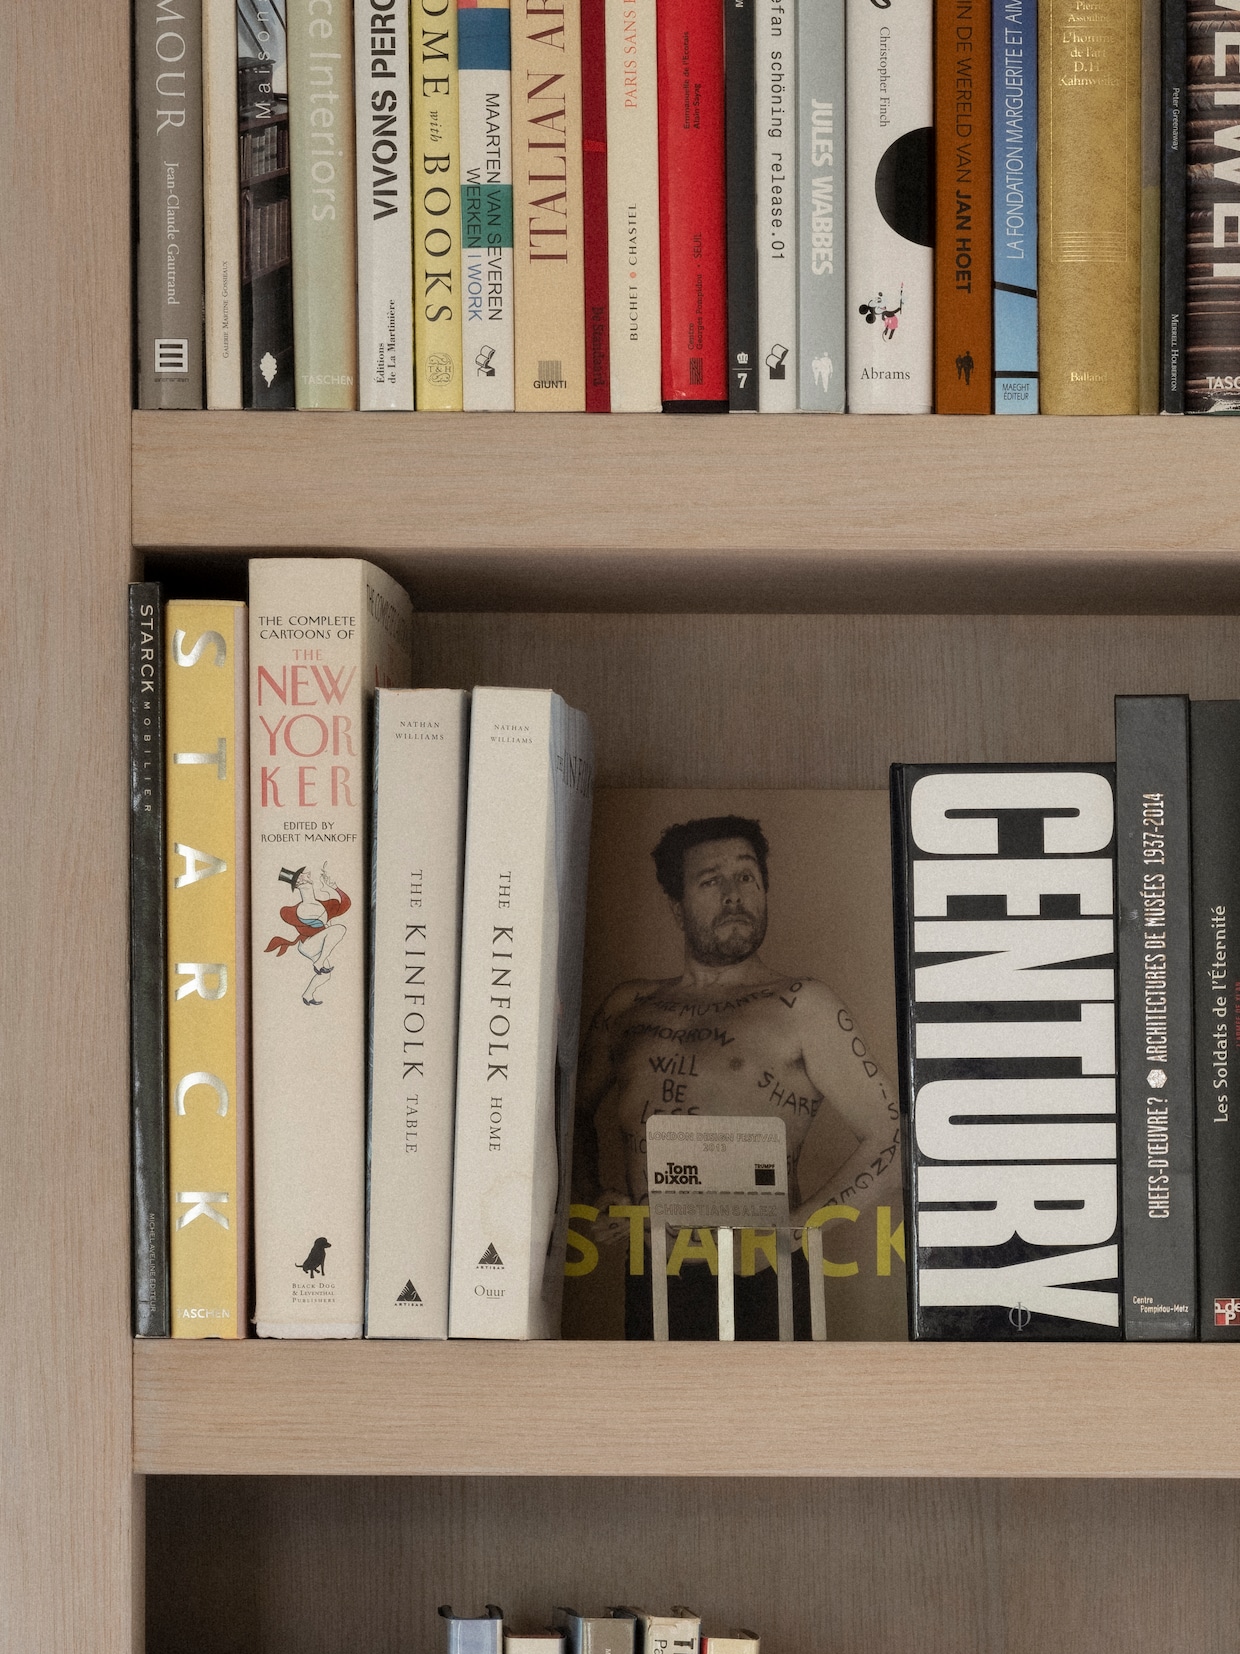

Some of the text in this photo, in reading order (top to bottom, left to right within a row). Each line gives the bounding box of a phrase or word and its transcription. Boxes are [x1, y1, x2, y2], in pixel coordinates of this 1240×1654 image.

[878, 26, 891, 128] Christopher Finch
[1170, 87, 1181, 151] Peter Greenaway
[485, 92, 503, 322] MAARTEN VAN SEVEREN
[526, 70, 569, 264] ITALIAN
[767, 50, 788, 262] schöning release.01
[811, 98, 834, 276] JULES WABBES
[164, 161, 181, 305] Jean-Claude Gautrand
[422, 152, 453, 323] BOOKS
[466, 167, 483, 322] WERKEN WORK
[628, 202, 638, 342] BUCHET CHASTEL
[955, 189, 972, 295] JAN HOET
[533, 380, 567, 389] GIUNTI
[861, 367, 911, 381] Abrams
[259, 628, 335, 641] CARTOONS
[288, 615, 357, 626] COMPLETE
[140, 604, 155, 813] STARCK MOBILIER
[394, 732, 445, 742] WILLIAMS
[399, 721, 440, 730] NATHAN
[260, 833, 358, 843] ROBERT MANKOFF
[173, 628, 231, 1232] STARCK
[403, 923, 426, 1154] KINFOLK TABLE
[486, 925, 514, 1152] KINFOLK HOME
[910, 771, 1120, 1328] CENTURY
[666, 1162, 699, 1175] Tom
